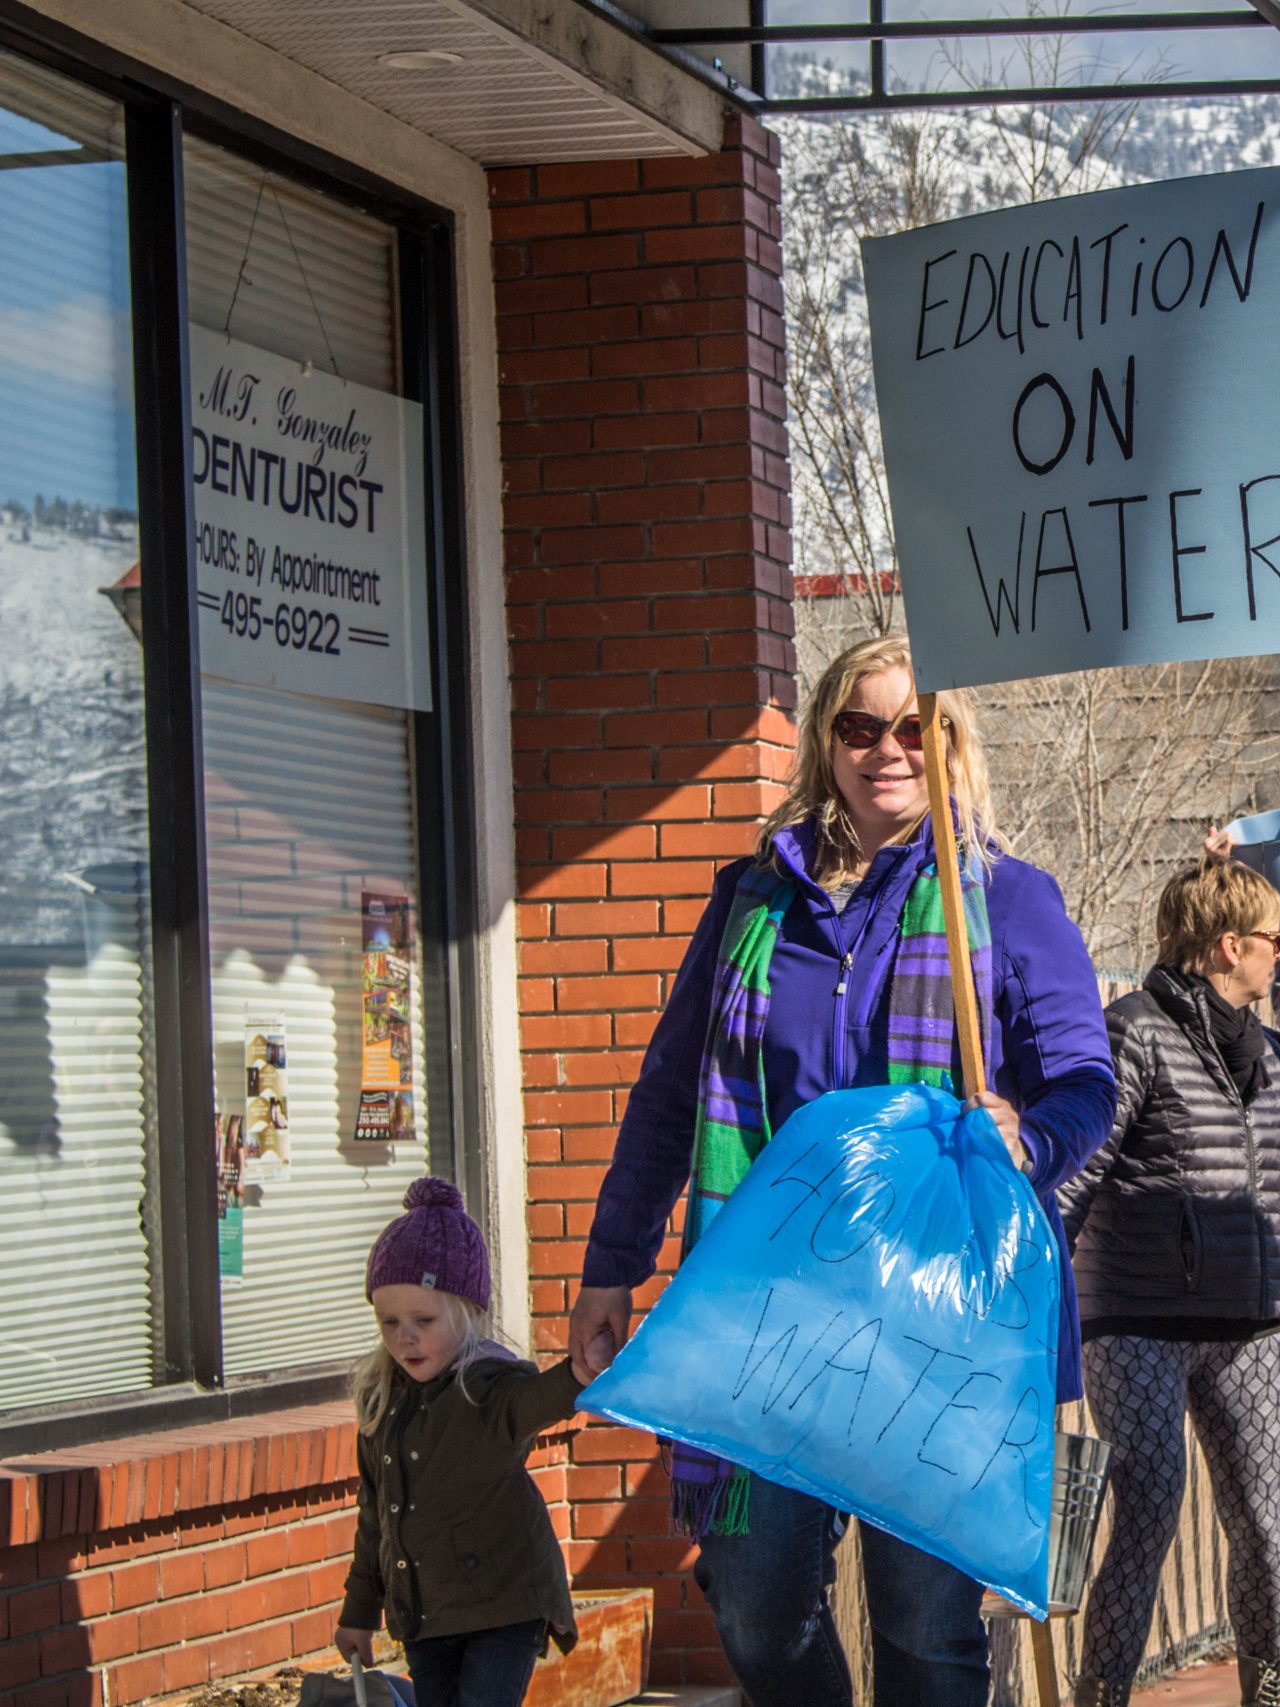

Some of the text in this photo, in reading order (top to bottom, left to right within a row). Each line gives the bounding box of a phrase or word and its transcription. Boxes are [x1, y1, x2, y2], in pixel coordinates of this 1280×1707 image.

[276, 386, 373, 476] Gonzalez
[1012, 355, 1136, 476] ON
[192, 426, 384, 533] DENTURIST
[246, 536, 266, 587] By
[271, 544, 381, 606] Appointment
[220, 589, 341, 656] 495-6922
[732, 1287, 1042, 1529] WATER
